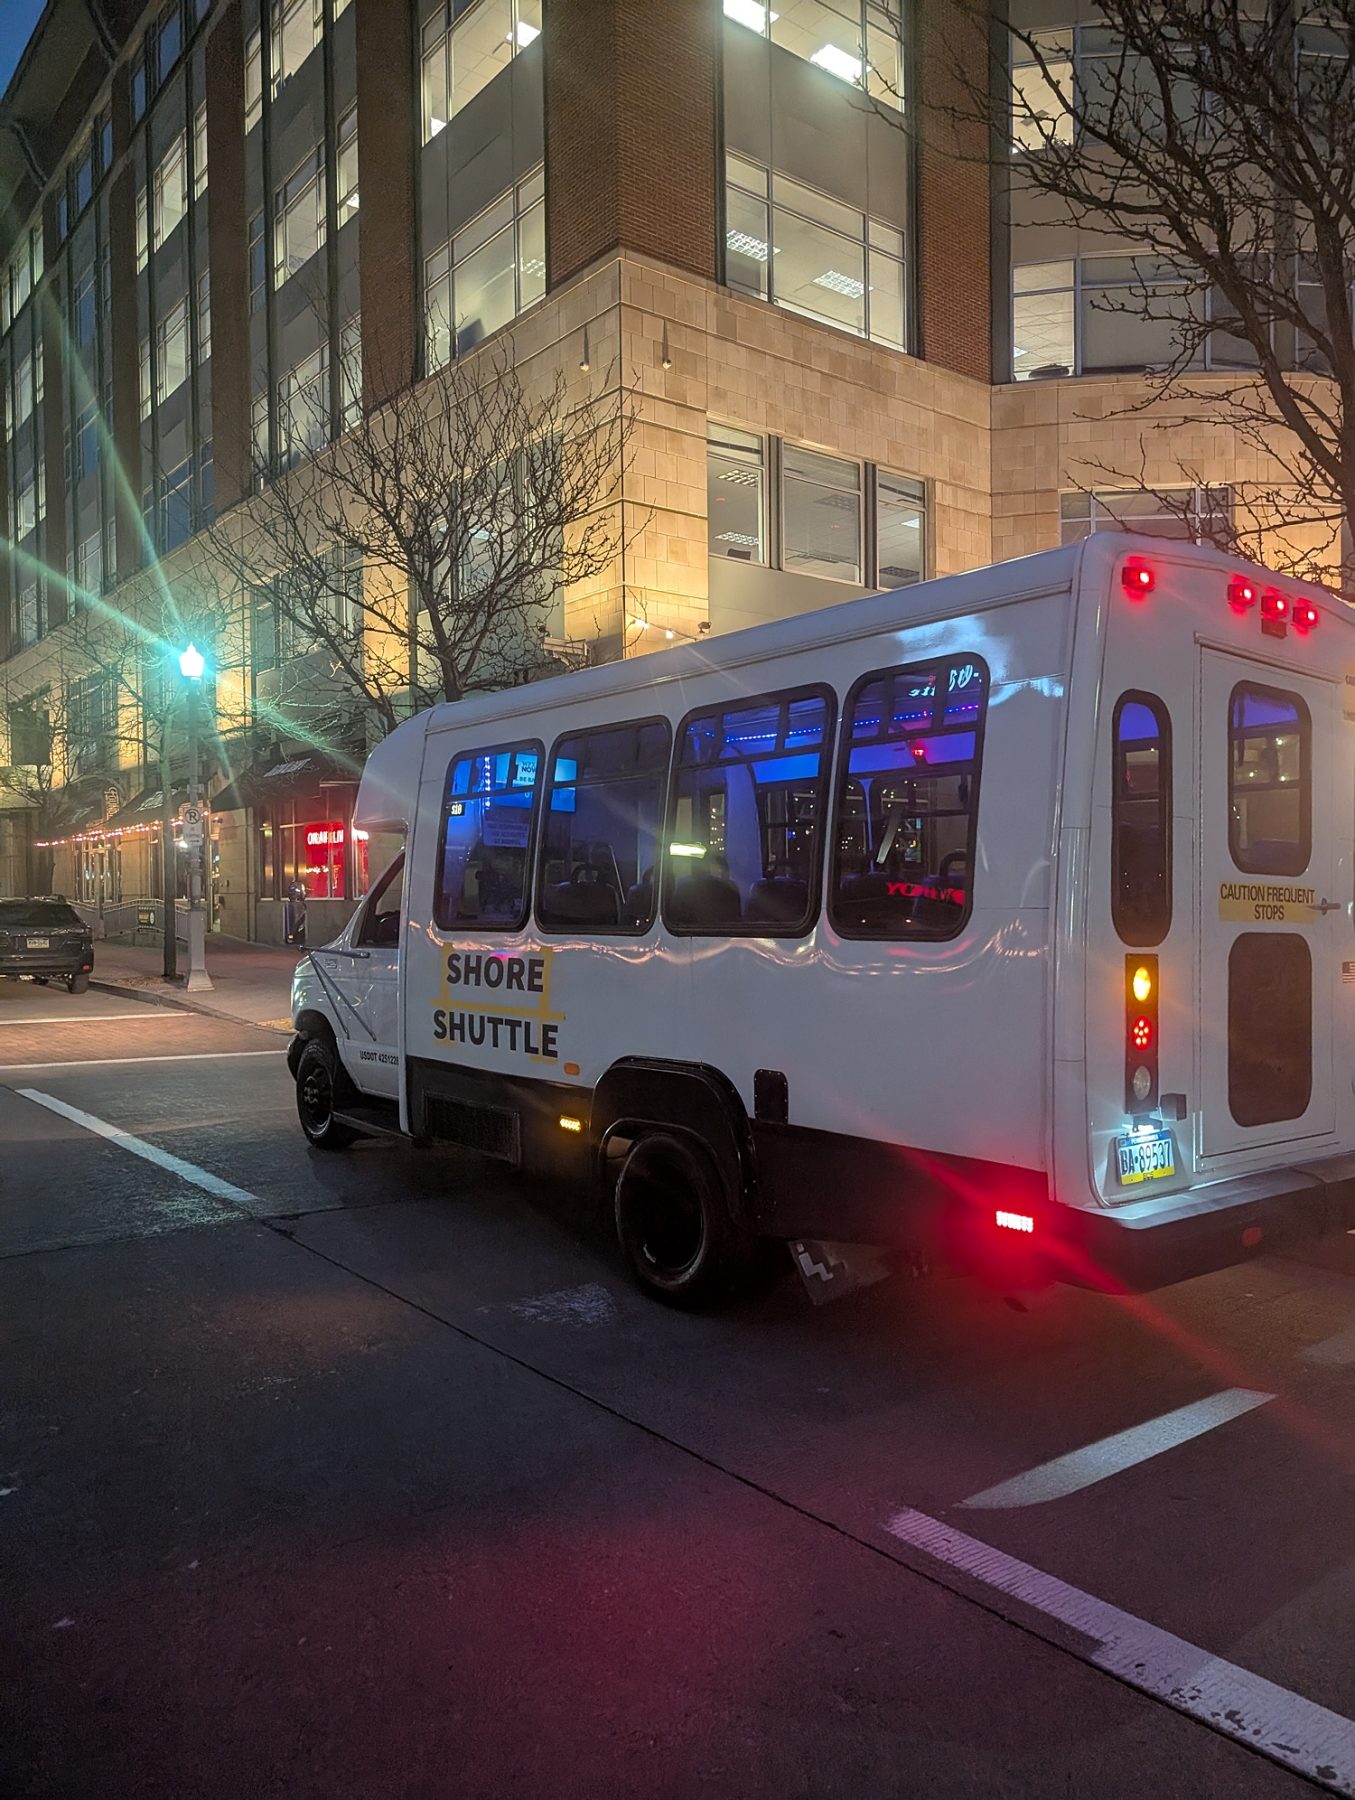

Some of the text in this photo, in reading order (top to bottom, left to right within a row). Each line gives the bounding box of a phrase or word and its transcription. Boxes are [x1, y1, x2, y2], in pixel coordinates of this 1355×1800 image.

[1220, 883, 1315, 904] CAUTION FREQUENT
[1254, 904, 1285, 920] STOPS
[446, 953, 545, 993] SHORE
[433, 1009, 559, 1058] SHUTTLE
[359, 1050, 377, 1062] USDOT
